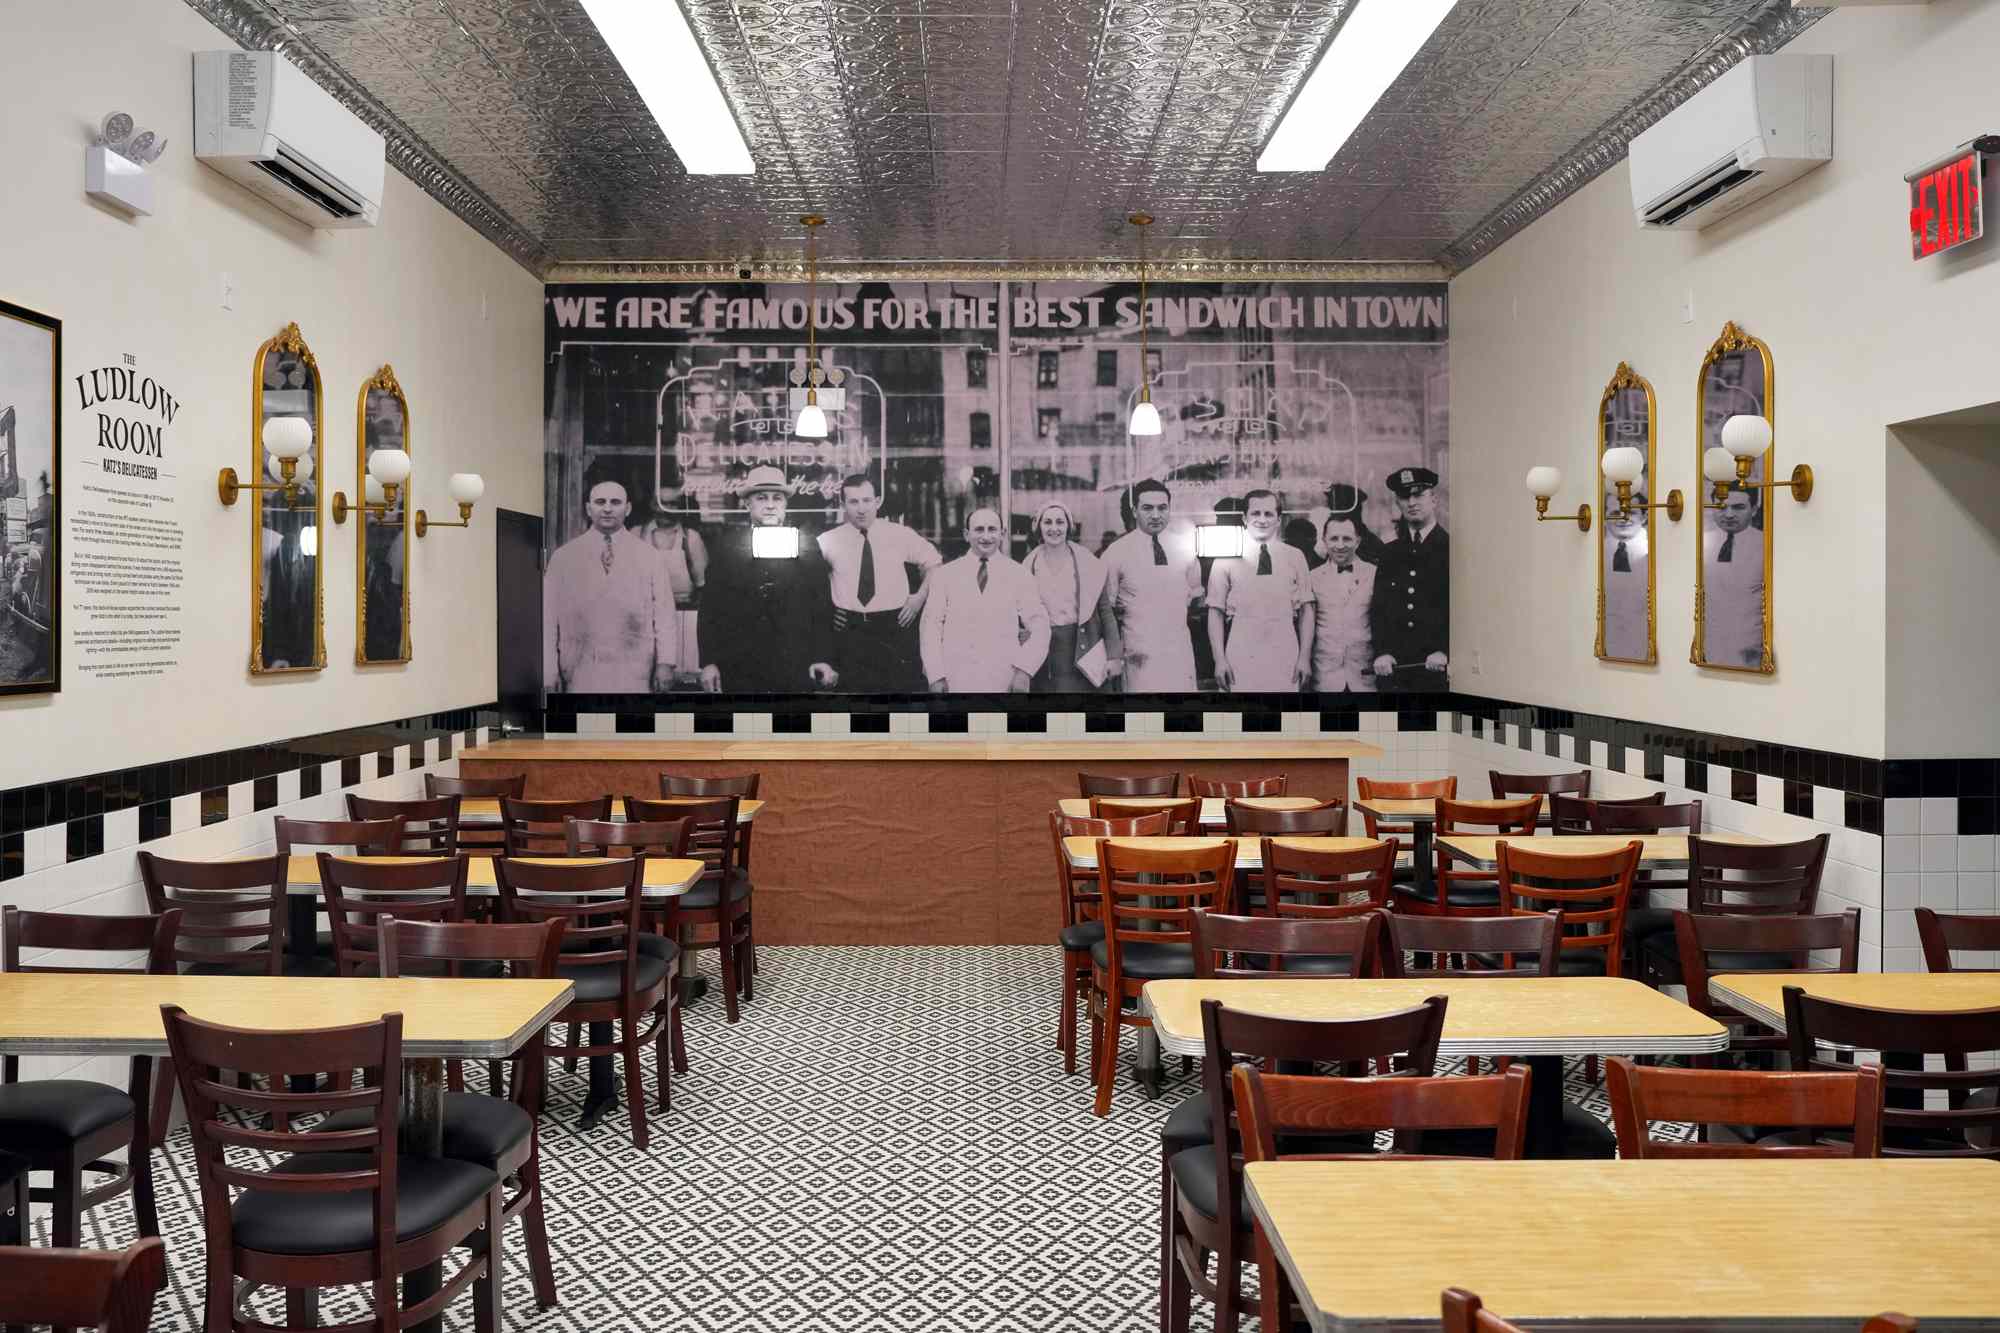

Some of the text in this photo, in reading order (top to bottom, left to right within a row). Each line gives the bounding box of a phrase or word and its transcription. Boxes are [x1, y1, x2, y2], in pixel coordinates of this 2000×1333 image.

[1920, 153, 1974, 256] EXIT
[553, 296, 1442, 329] WE ARE FAMOUS FOR THE BEST SANDWICH IN TOWN
[122, 353, 136, 366] THE
[75, 367, 180, 425] LUDLOW
[97, 413, 162, 458] ROOM
[677, 432, 871, 467] DELICATESSEN
[103, 458, 158, 480] KATZ'S DELICATESSEN
